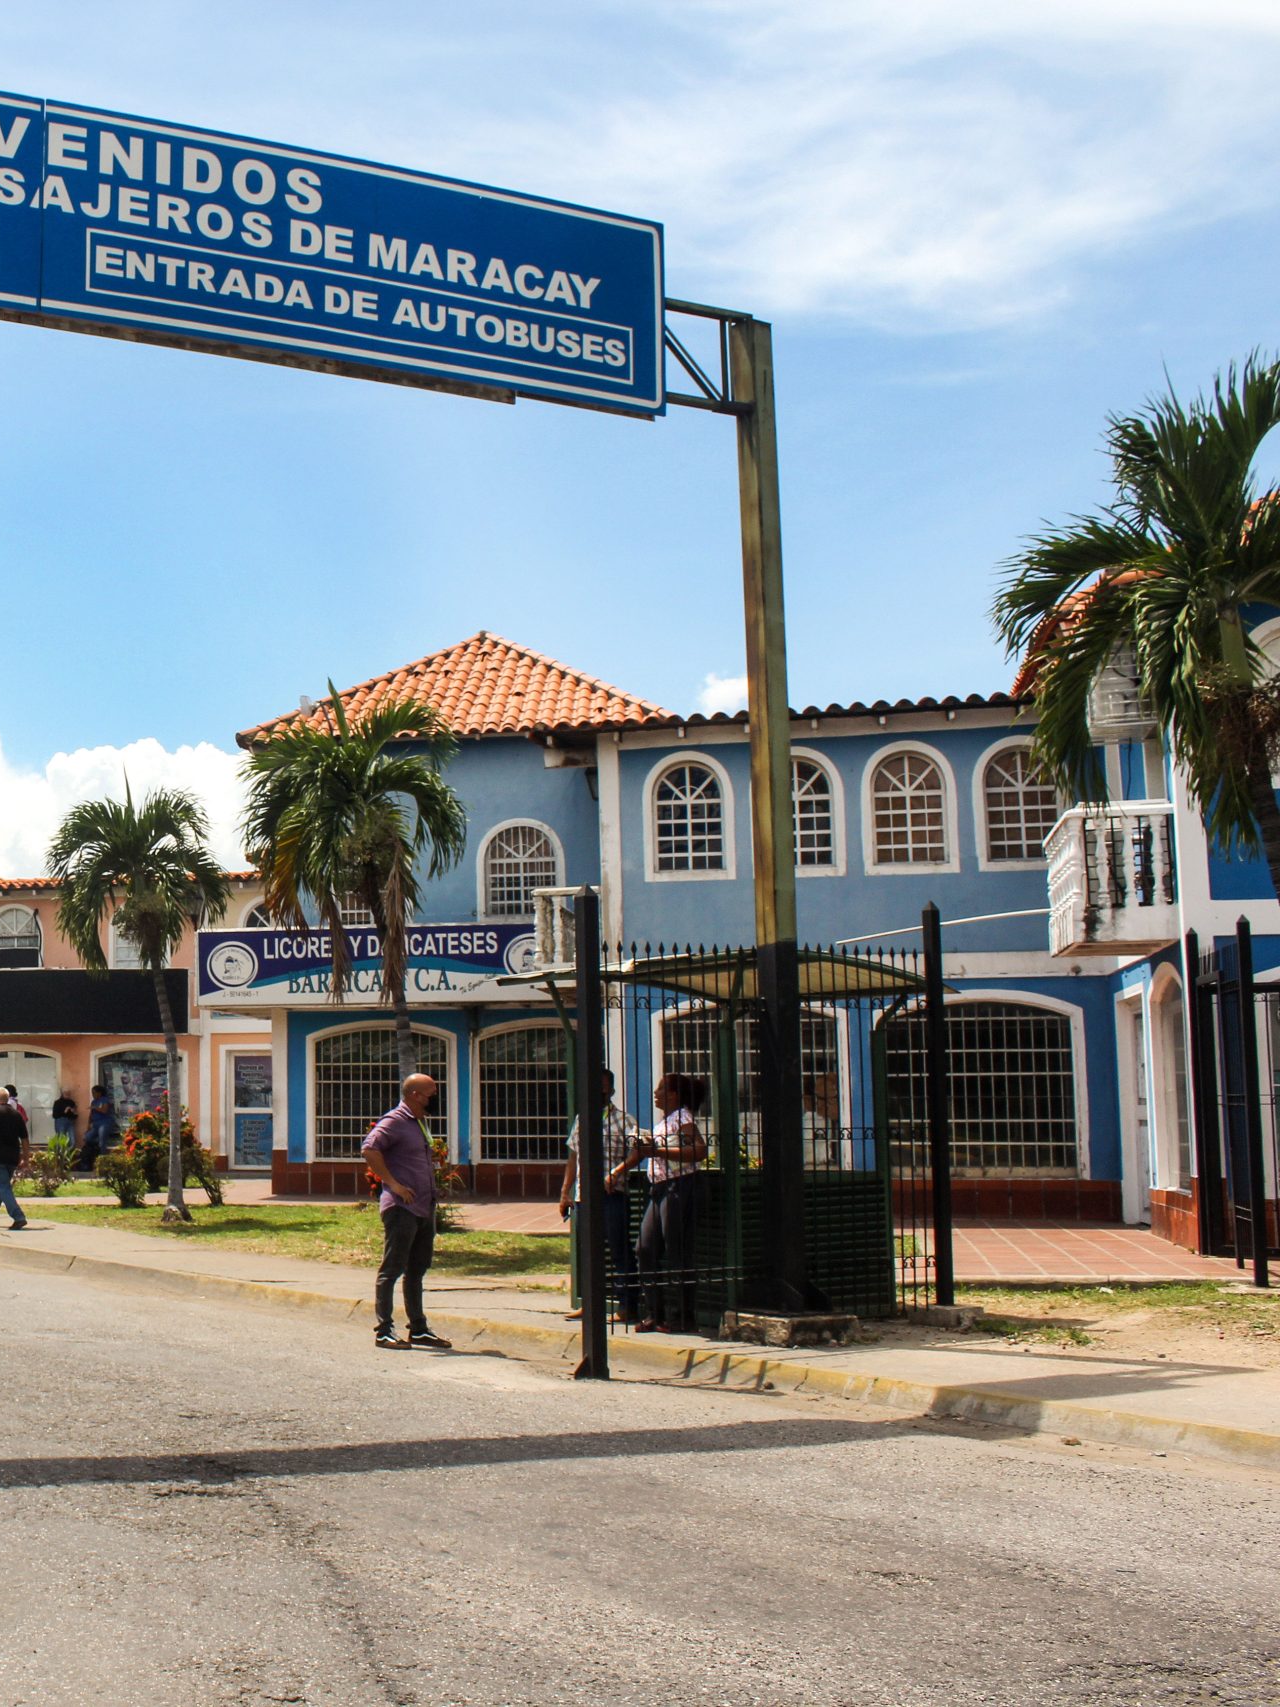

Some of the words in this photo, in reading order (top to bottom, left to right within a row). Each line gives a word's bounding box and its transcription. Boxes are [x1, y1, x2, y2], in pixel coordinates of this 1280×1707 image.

[95, 245, 314, 309] ENTRADA
[324, 285, 379, 321] DE
[393, 298, 626, 367] AUTOBUSES
[289, 218, 354, 263] DE
[368, 233, 601, 309] MARACAY
[263, 936, 338, 959] LICORE
[350, 935, 362, 957] Y
[367, 931, 498, 957] DICATESES
